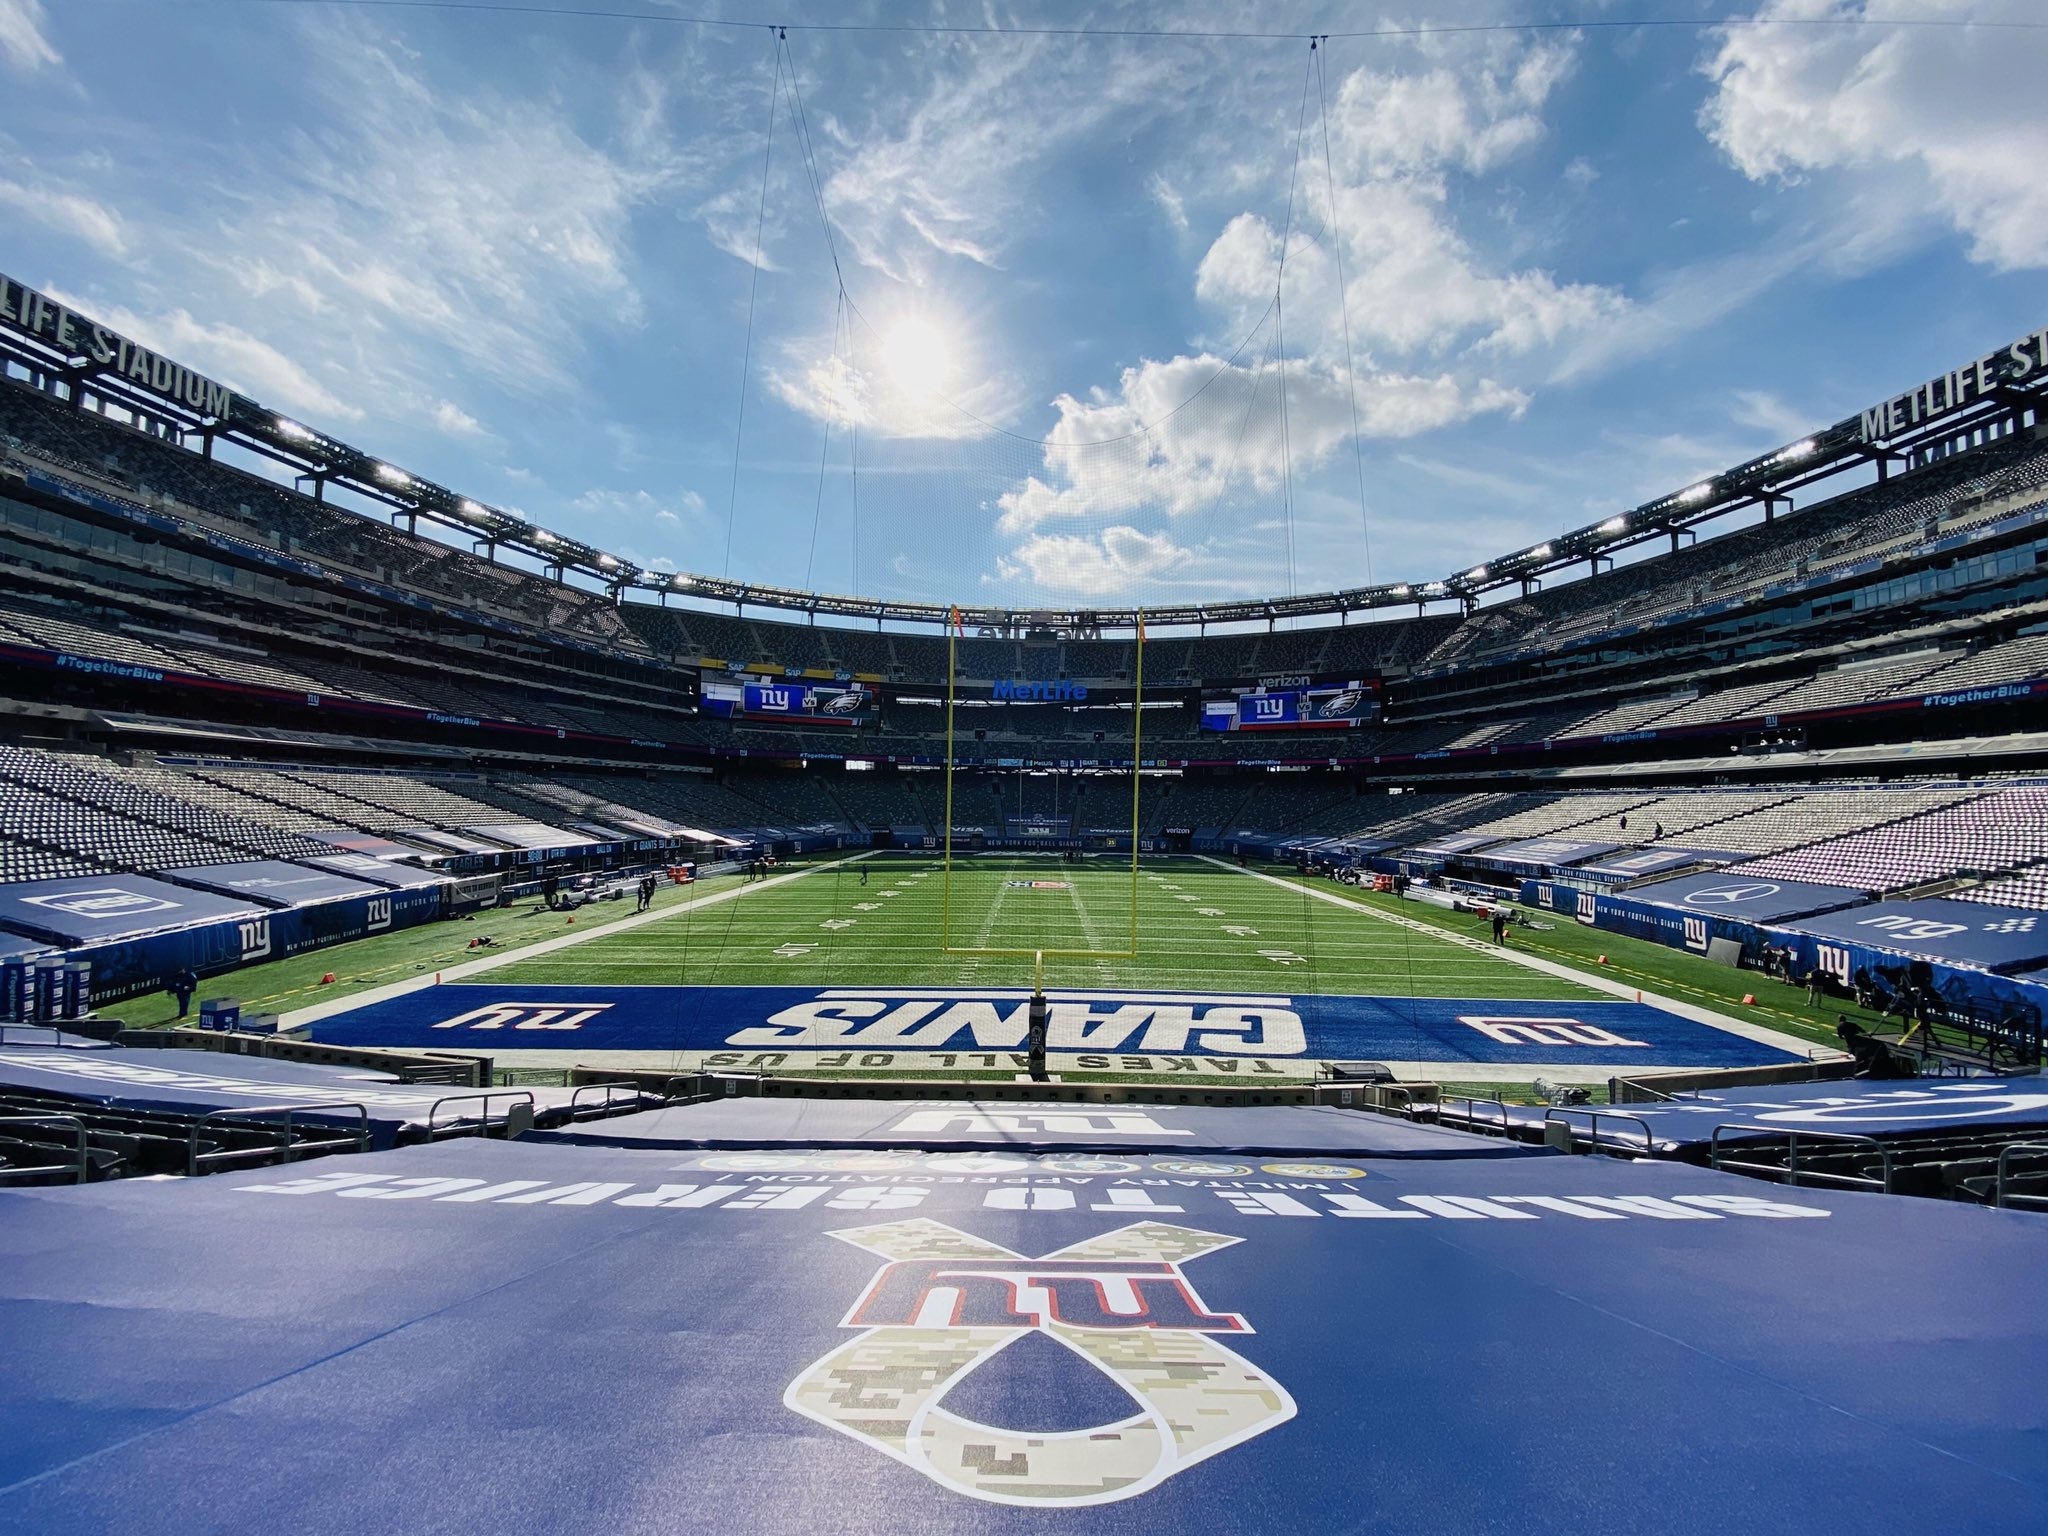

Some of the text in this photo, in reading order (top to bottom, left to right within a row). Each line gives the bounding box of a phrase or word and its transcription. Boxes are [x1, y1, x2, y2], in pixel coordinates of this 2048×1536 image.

[91, 325, 232, 420] STADIUM
[1861, 352, 1997, 444] METLIFE
[57, 655, 163, 681] #TogetherBlue
[728, 662, 744, 671] SAP
[785, 668, 801, 677] SAP
[836, 672, 851, 681] SAP
[993, 679, 1088, 700] MetLife
[1258, 674, 1311, 688] verizon
[760, 688, 789, 711] ny
[1923, 684, 2031, 707] #TogetherBlue
[1255, 698, 1283, 718] ny
[426, 712, 480, 727] #TogetherBlue
[630, 739, 666, 749] #TogetherBlue
[1603, 731, 1657, 743] #TogetherBlue
[1166, 826, 1190, 835] verizon
[640, 839, 657, 850] GIANTS
[923, 836, 935, 847] ny
[1005, 839, 1021, 847] YORK
[1059, 840, 1082, 848] GIANTS
[1140, 840, 1153, 850] ny
[454, 855, 484, 869] EAGLES
[1538, 885, 1553, 907] ny
[368, 898, 391, 931] ny
[1577, 892, 1596, 924] ny
[1597, 905, 1683, 931] NEW YORK FOOTBALL GIANTS
[1684, 916, 1706, 950] ny
[1856, 915, 1969, 940] nrg
[238, 919, 271, 961] ny
[1817, 943, 1850, 987] ny
[90, 977, 161, 1003] OOTBALL GIANTS
[725, 1000, 1307, 1054] GIANTS
[702, 1053, 788, 1067] US
[815, 1053, 895, 1067] OF
[1077, 1055, 1286, 1074] TAKES
[1597, 1084, 2009, 1116] OAKLEY
[889, 1111, 1195, 1135] ny
[744, 1175, 1331, 1191] MILITARY APPRECIATION
[230, 1172, 1832, 1220] SALUTE TO SERVICE
[838, 1258, 1257, 1334] ny
